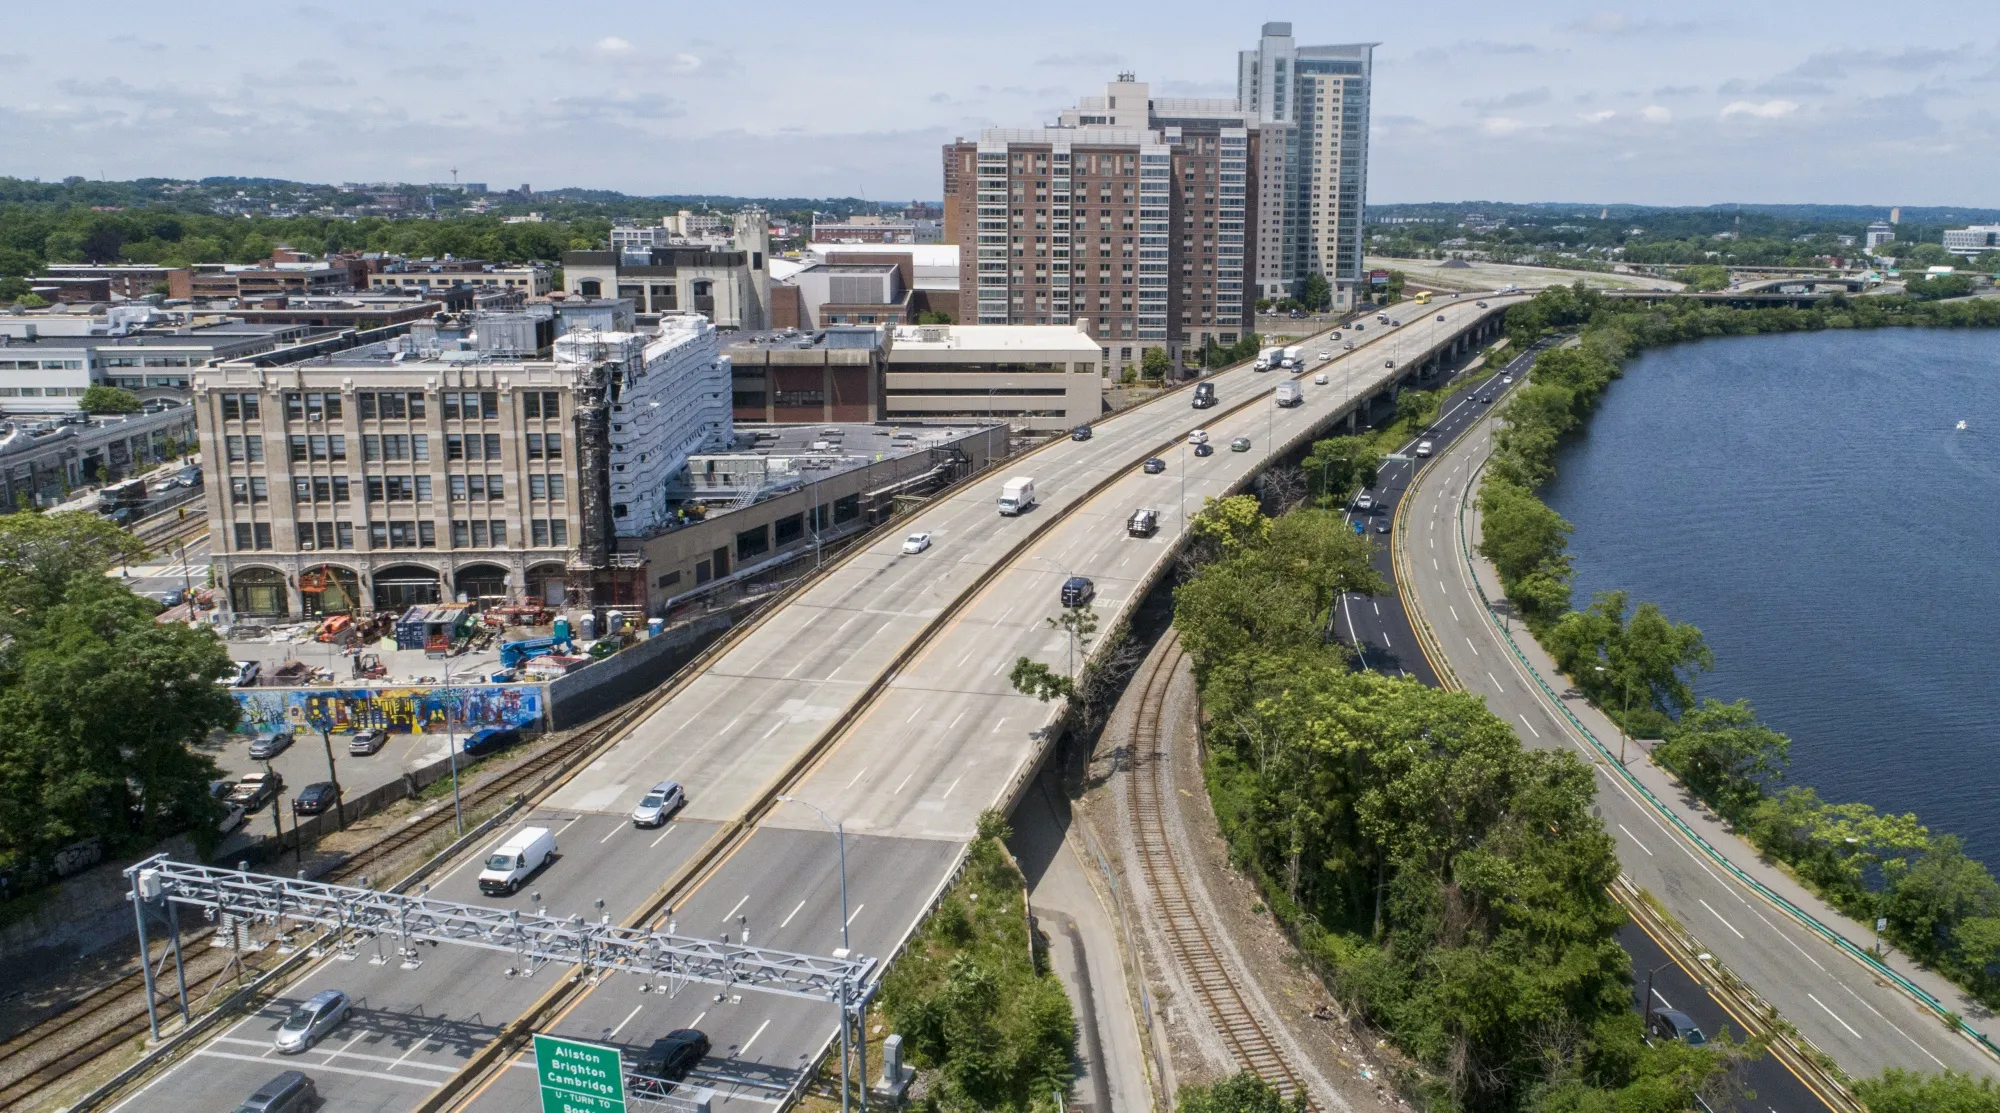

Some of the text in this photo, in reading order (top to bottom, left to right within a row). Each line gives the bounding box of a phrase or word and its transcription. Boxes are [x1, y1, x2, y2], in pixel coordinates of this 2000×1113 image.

[555, 1046, 600, 1064] Allston
[551, 1059, 606, 1078] Brighton
[547, 1072, 614, 1094] Cambridge
[563, 1104, 596, 1113] Bost
[599, 1100, 611, 1109] TO
